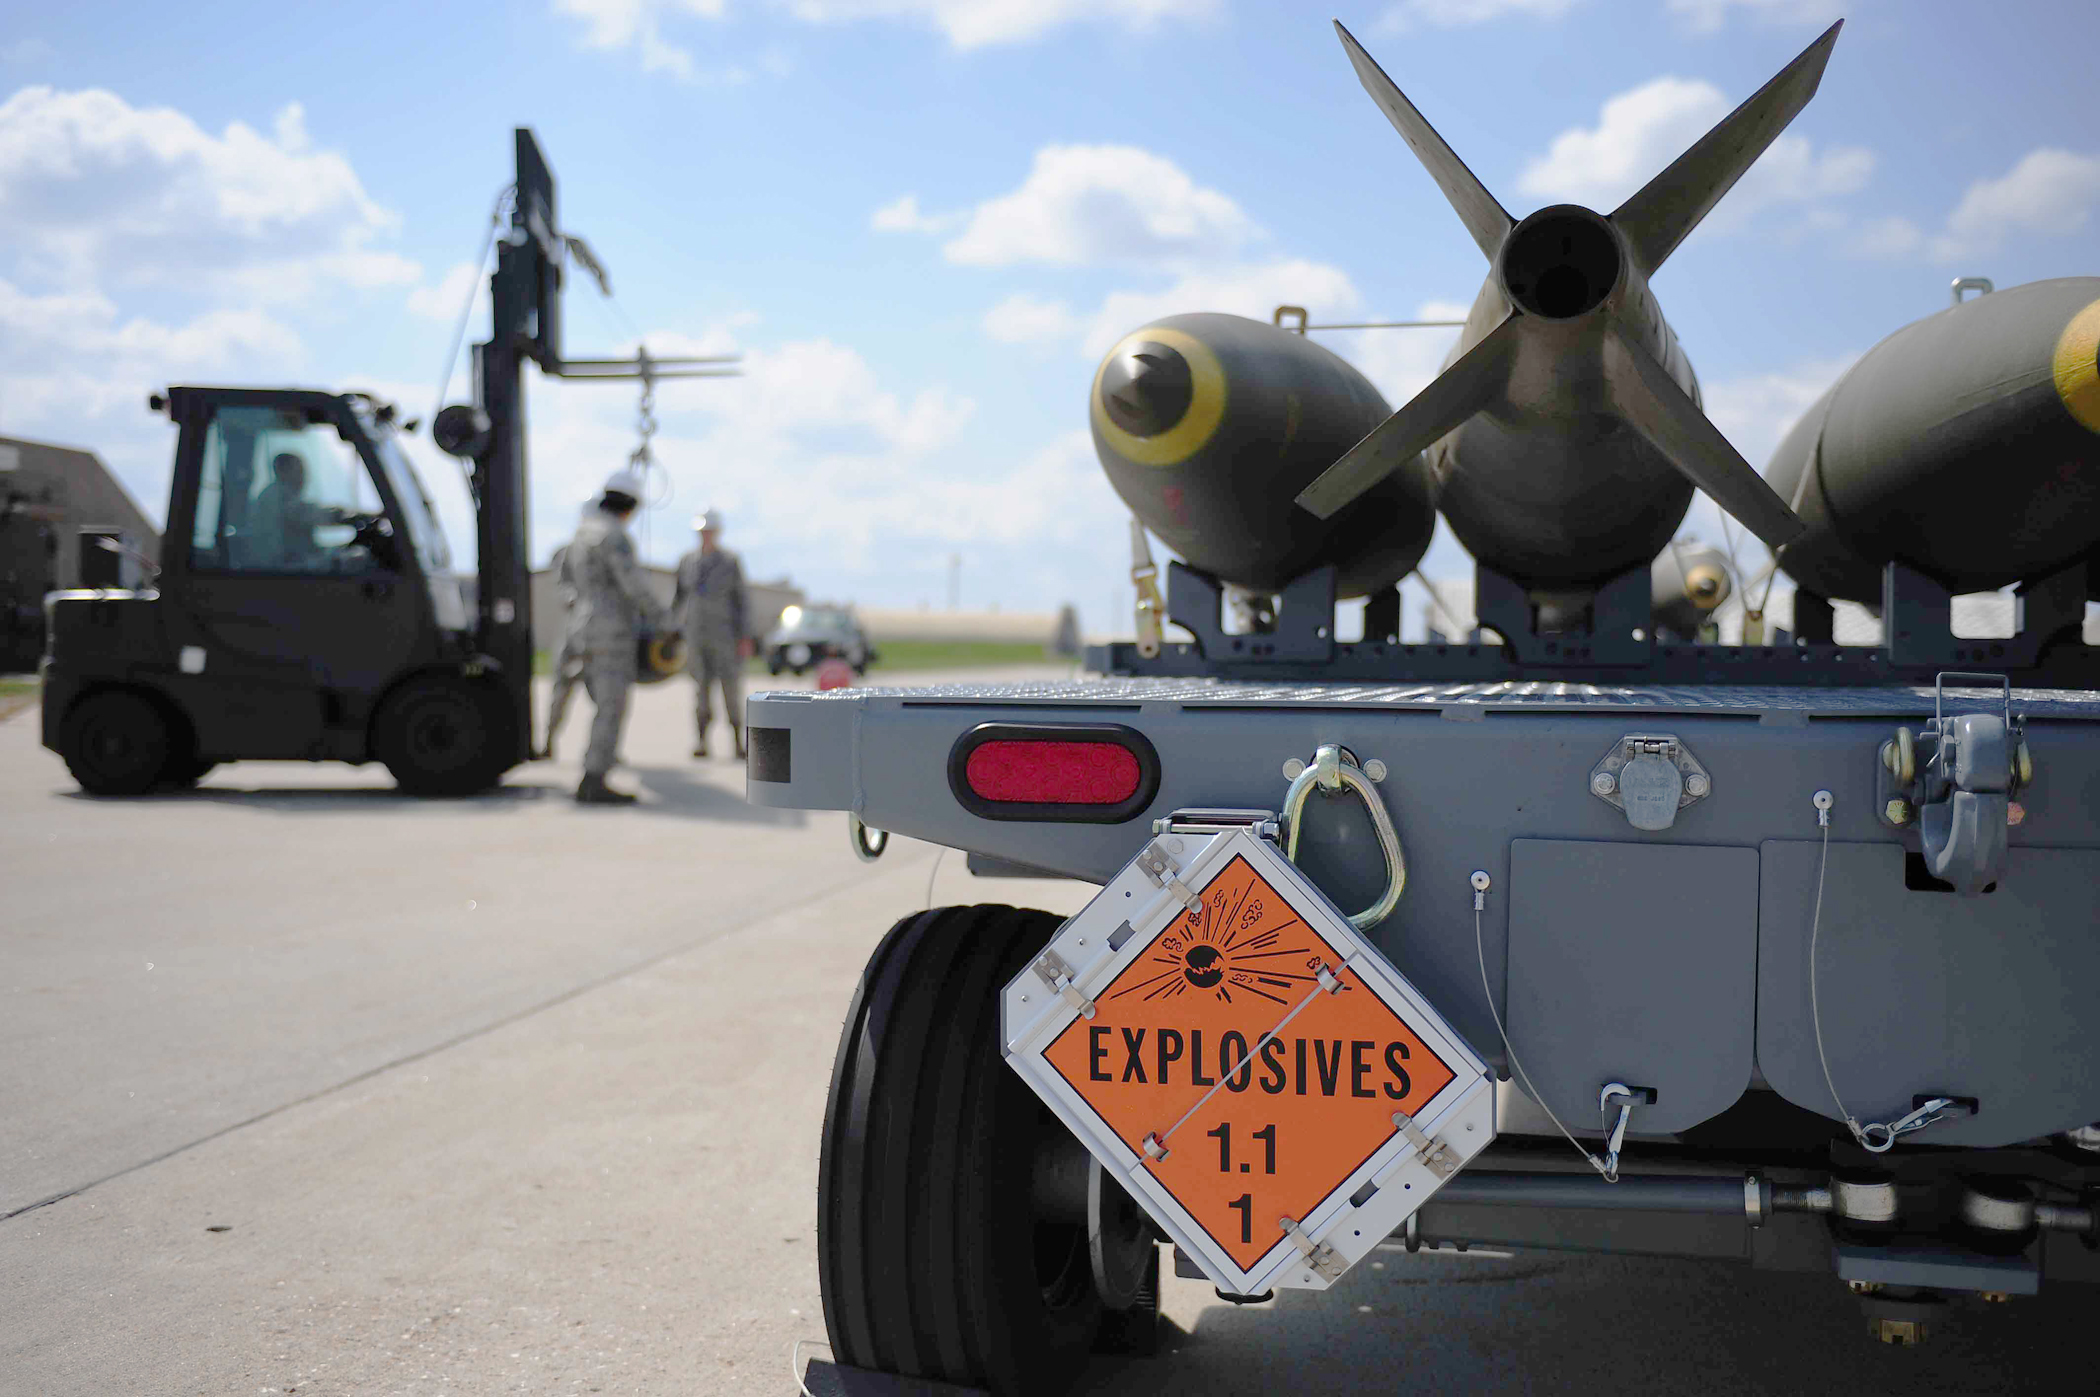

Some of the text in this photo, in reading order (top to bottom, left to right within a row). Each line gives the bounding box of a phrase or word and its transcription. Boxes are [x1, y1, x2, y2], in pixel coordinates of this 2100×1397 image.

[1088, 1025, 1412, 1101] EXPLOSIVES
[1206, 1122, 1276, 1175] 1.1
[1228, 1193, 1252, 1244] 1
